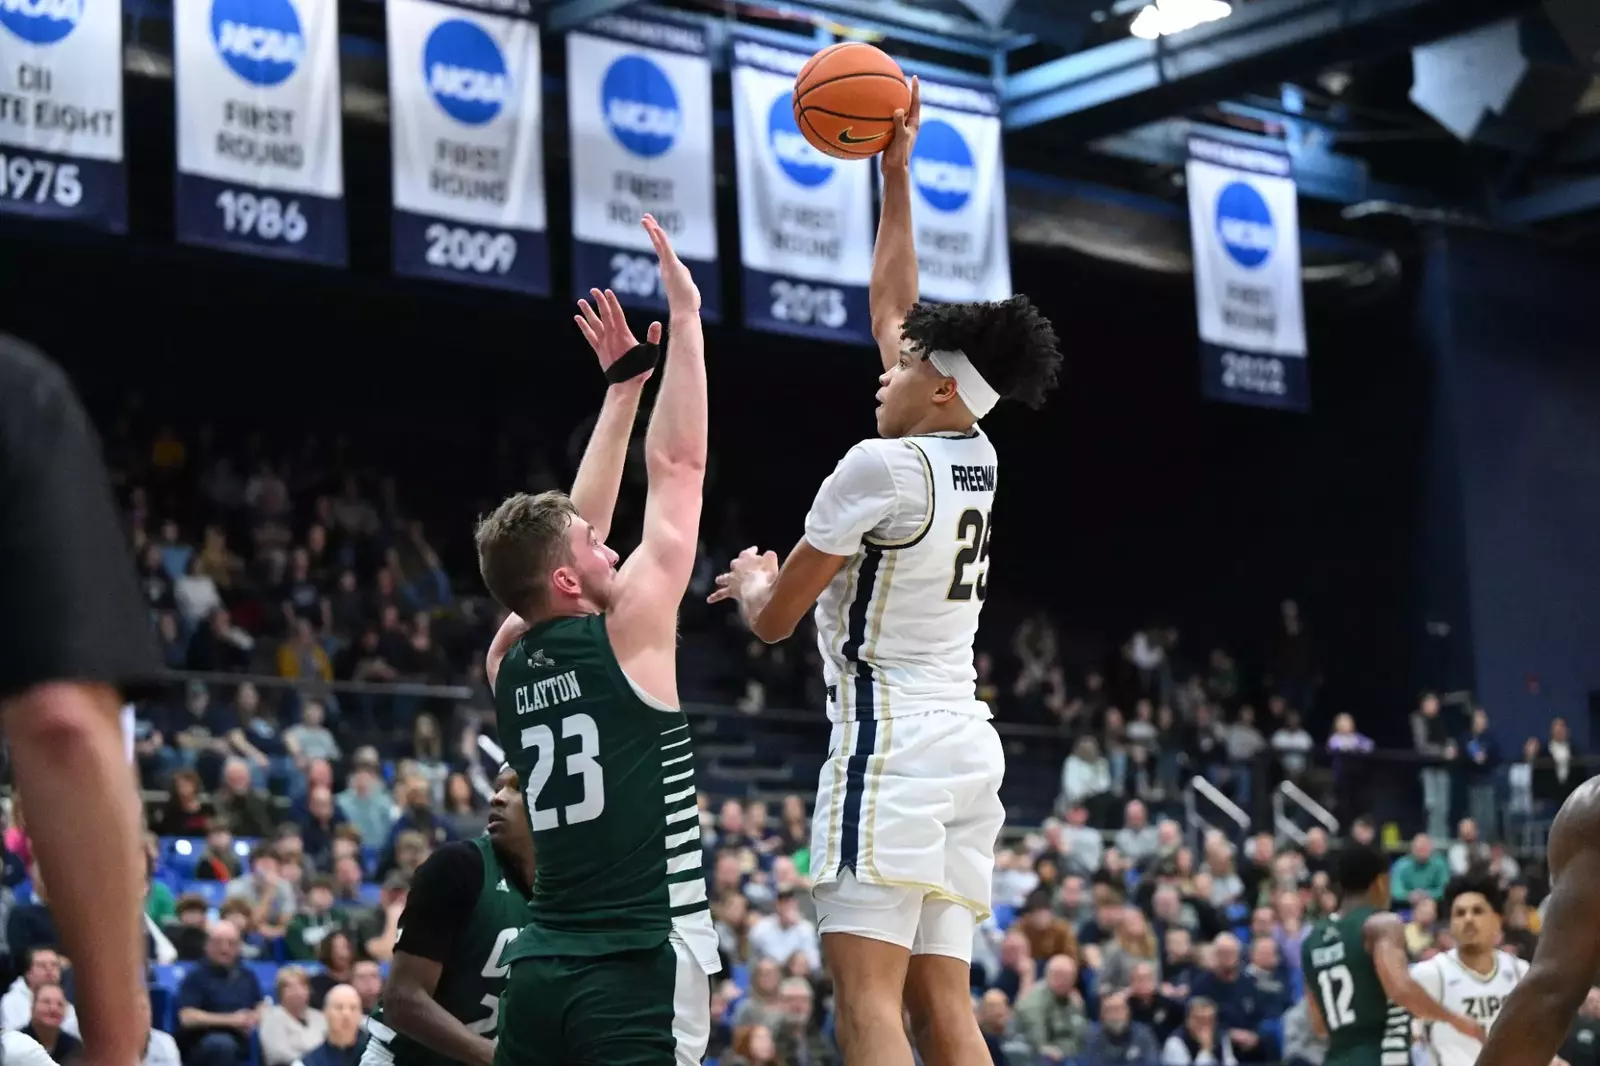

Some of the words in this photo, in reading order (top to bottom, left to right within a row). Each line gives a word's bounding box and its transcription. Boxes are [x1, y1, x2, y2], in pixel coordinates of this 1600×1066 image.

[218, 20, 300, 64] NCAA
[430, 62, 507, 103] NCAA
[35, 102, 116, 136] EIGHT
[224, 101, 295, 133] FIRST
[216, 133, 304, 170] ROUND
[0, 155, 82, 207] 1975
[429, 168, 508, 204] ROUND
[215, 190, 307, 242] 1986
[425, 223, 516, 274] 2009
[515, 670, 582, 715] CLAYTON
[521, 713, 605, 831] 23
[1317, 964, 1356, 1030] 12
